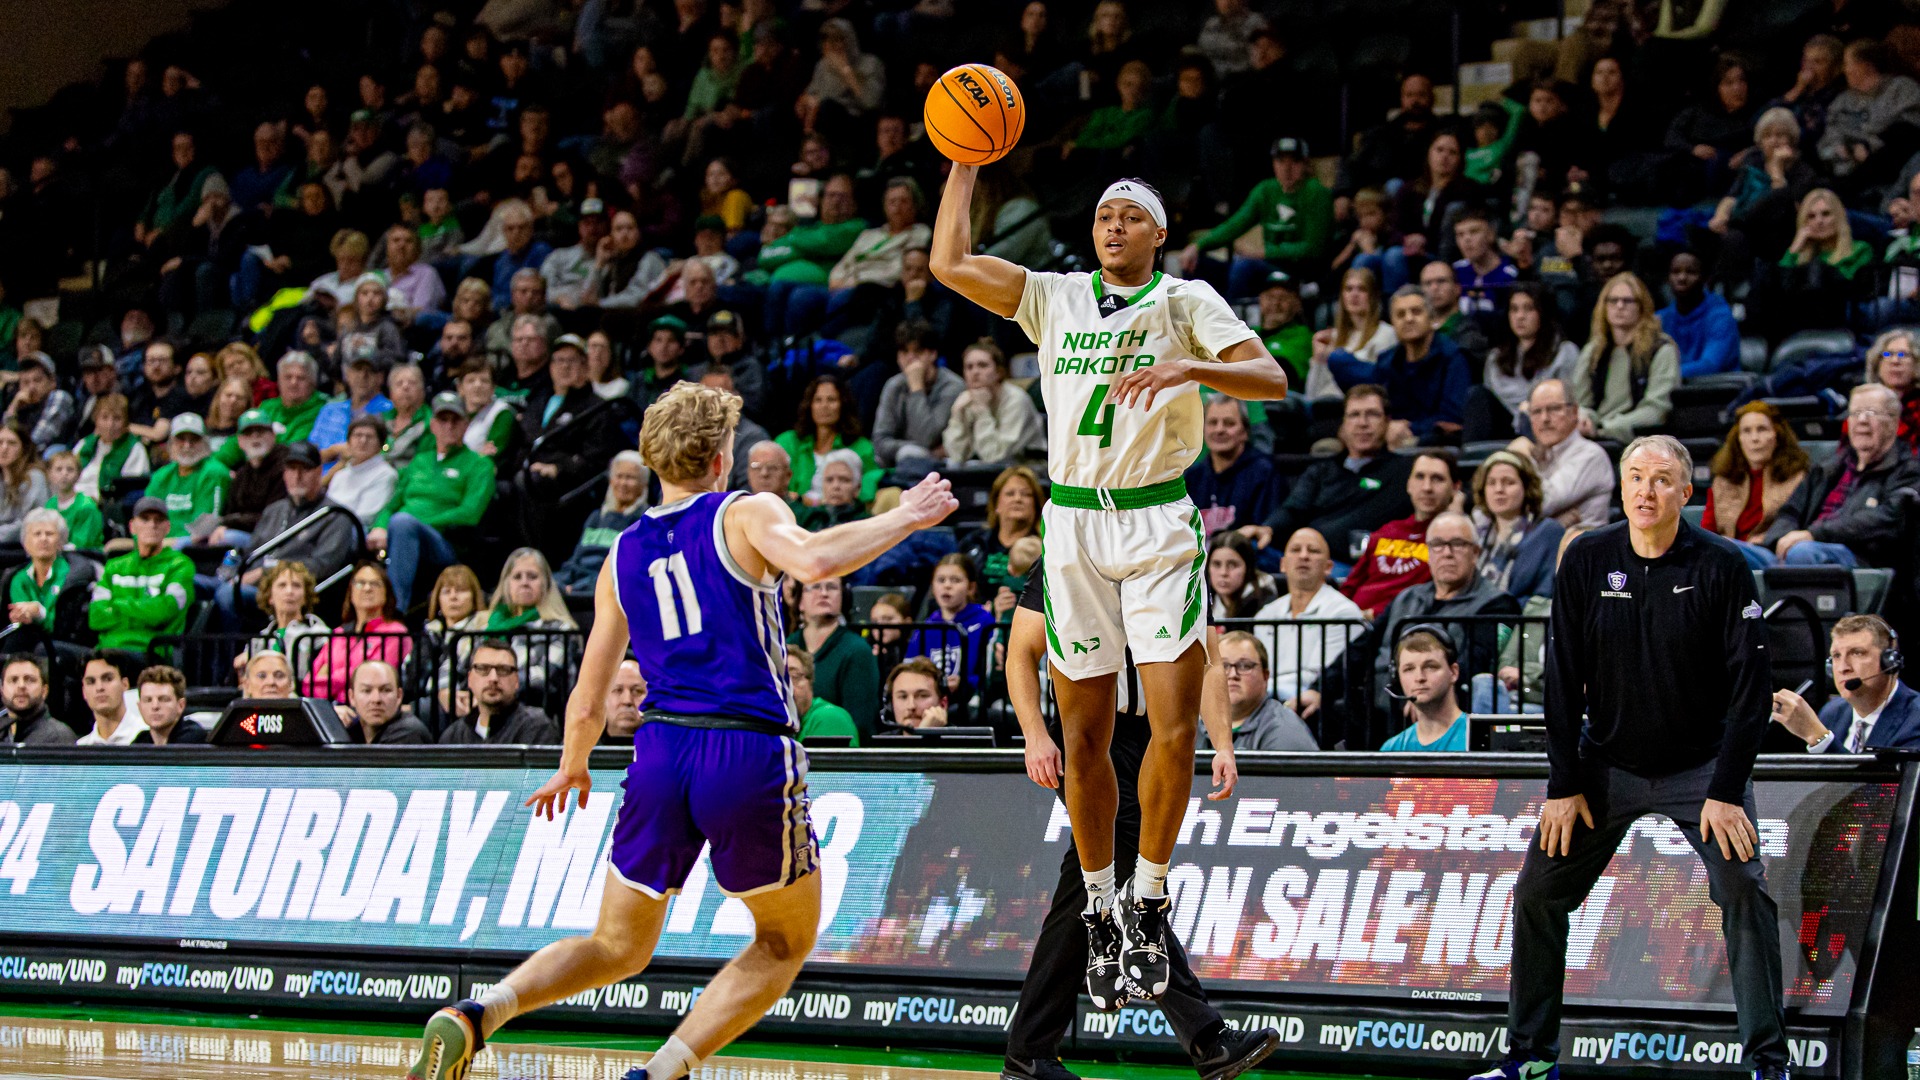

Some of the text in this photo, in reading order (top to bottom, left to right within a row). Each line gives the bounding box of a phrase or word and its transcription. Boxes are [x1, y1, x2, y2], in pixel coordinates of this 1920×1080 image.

[954, 72, 991, 109] NCAA
[1062, 329, 1149, 353] NORTH
[1054, 354, 1156, 376] DAKOTA
[1077, 383, 1117, 449] 4
[648, 550, 703, 641] 11
[1600, 590, 1633, 599] BASKETBALL
[257, 714, 284, 734] POSS
[69, 783, 511, 942] SATURDAY,
[1251, 864, 1427, 963] SALE
[180, 938, 228, 950] DAKTRONICS
[116, 962, 274, 993] myFCCU.com/UND
[284, 969, 451, 1002] myFCCU.com/UND
[1411, 989, 1483, 1001] DAKTRONICS
